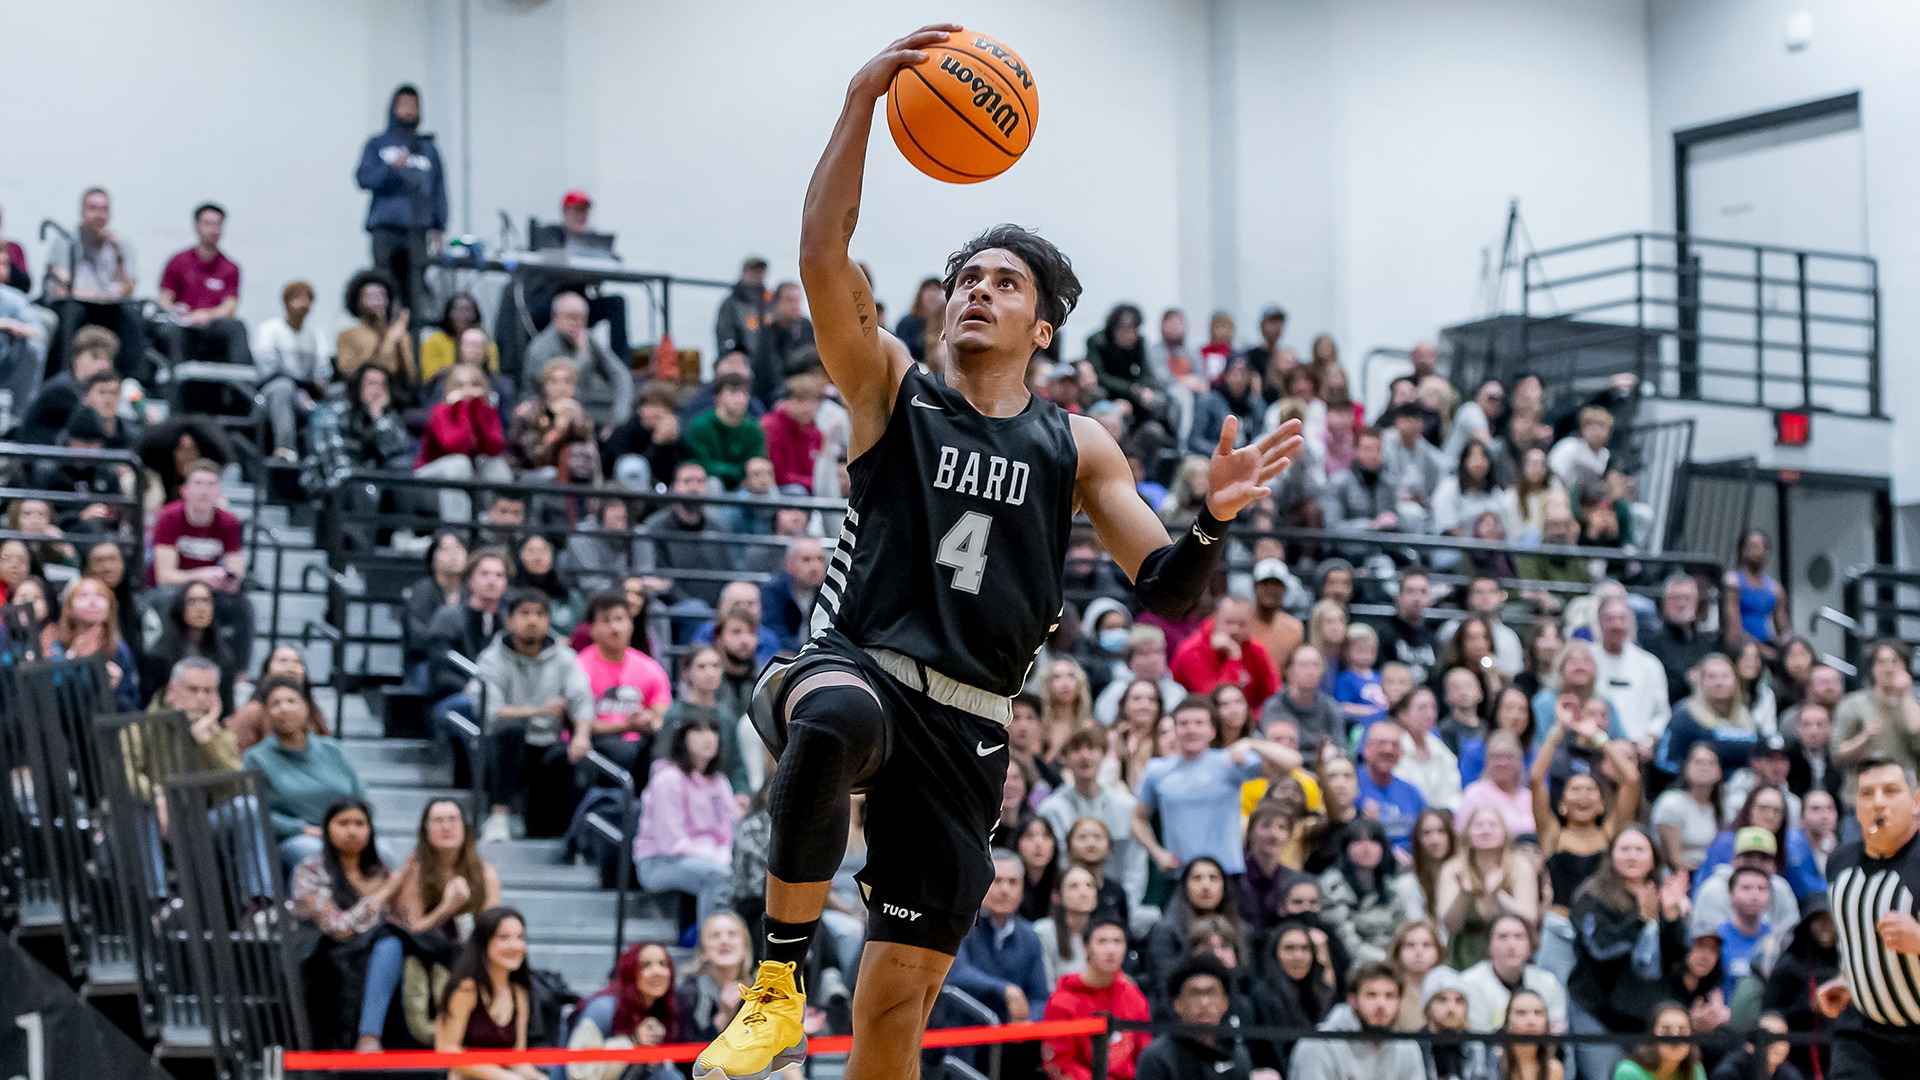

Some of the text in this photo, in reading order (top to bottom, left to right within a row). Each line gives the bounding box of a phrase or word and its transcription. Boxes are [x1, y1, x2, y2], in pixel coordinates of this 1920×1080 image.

[975, 37, 1033, 90] NCAA
[940, 54, 1020, 139] Wilson
[933, 445, 1030, 506] BARD
[935, 510, 993, 595] 4
[882, 902, 923, 922] TUOY
